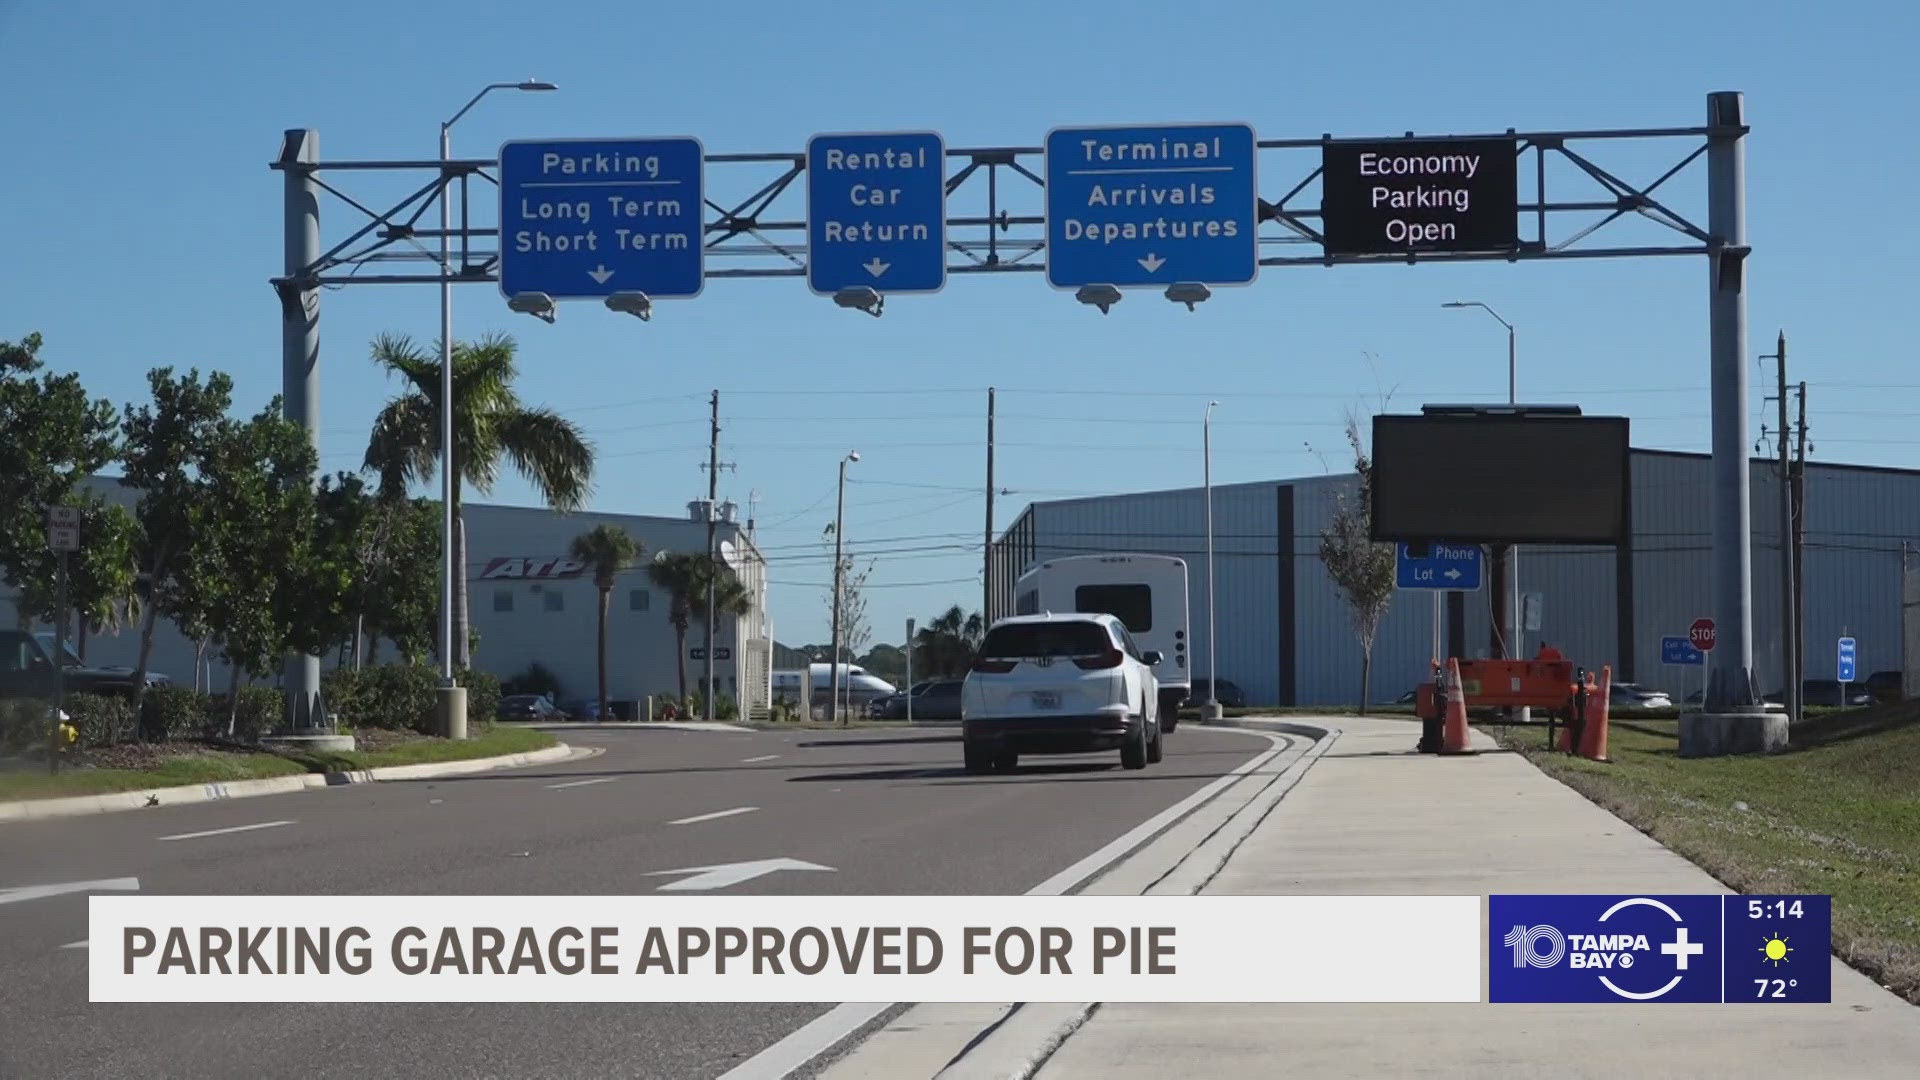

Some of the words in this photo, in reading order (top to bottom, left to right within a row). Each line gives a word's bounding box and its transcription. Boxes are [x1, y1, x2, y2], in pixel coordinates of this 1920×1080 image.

[826, 147, 925, 170] Rental
[1081, 137, 1221, 161] Terminal
[543, 151, 659, 179] Parking
[1360, 153, 1480, 178] Economy
[849, 184, 901, 206] Car
[1087, 183, 1216, 206] Arrivals
[1372, 185, 1469, 212] Parking
[521, 198, 591, 220] Long
[607, 197, 681, 217] Term
[515, 230, 597, 252] Short
[615, 229, 688, 250] Term
[825, 221, 928, 243] Return
[1063, 217, 1239, 245] Departures
[1385, 218, 1456, 246] Open
[1435, 545, 1475, 560] Phone
[482, 557, 586, 579] ATP
[1414, 567, 1434, 581] Lot
[1691, 627, 1717, 641] STOP
